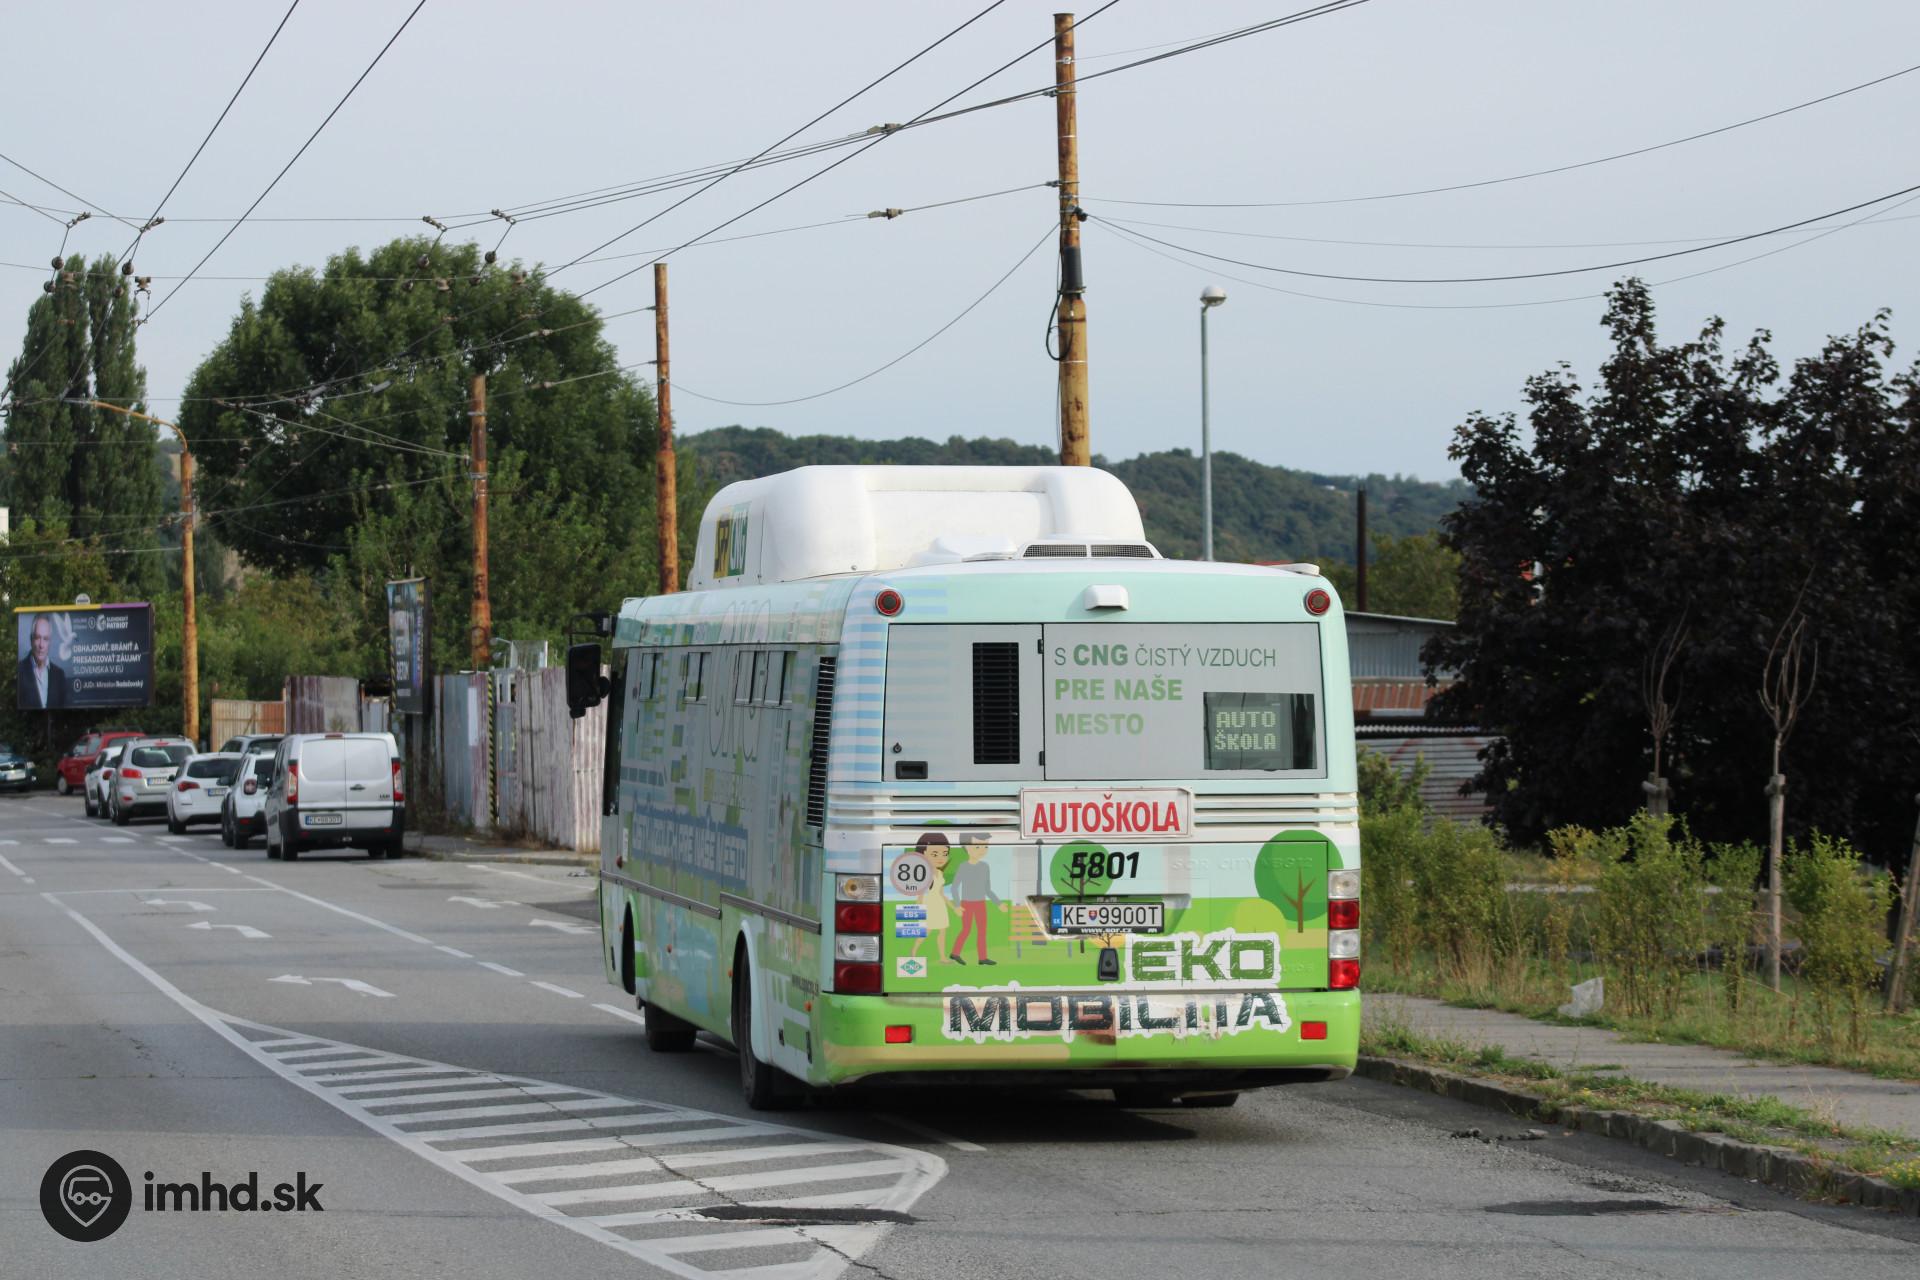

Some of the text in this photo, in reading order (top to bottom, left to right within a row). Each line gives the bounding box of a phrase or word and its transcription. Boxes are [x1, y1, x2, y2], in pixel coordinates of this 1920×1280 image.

[106, 621, 128, 629] PATRIOT
[1054, 643, 1276, 667] S CNG ČISTÝ VZDUCH
[1055, 674, 1183, 700] PRE NAŠE
[1055, 713, 1144, 735] MESTO
[1216, 711, 1276, 728] AUTO
[1215, 729, 1276, 750] ŠKOLA
[1031, 793, 1180, 833] AUTOŠKOLA
[897, 864, 927, 882] 80
[1070, 851, 1140, 879] 5801
[1063, 907, 1087, 925] KE
[1098, 907, 1159, 925] 9900T
[1131, 939, 1275, 981] EKO
